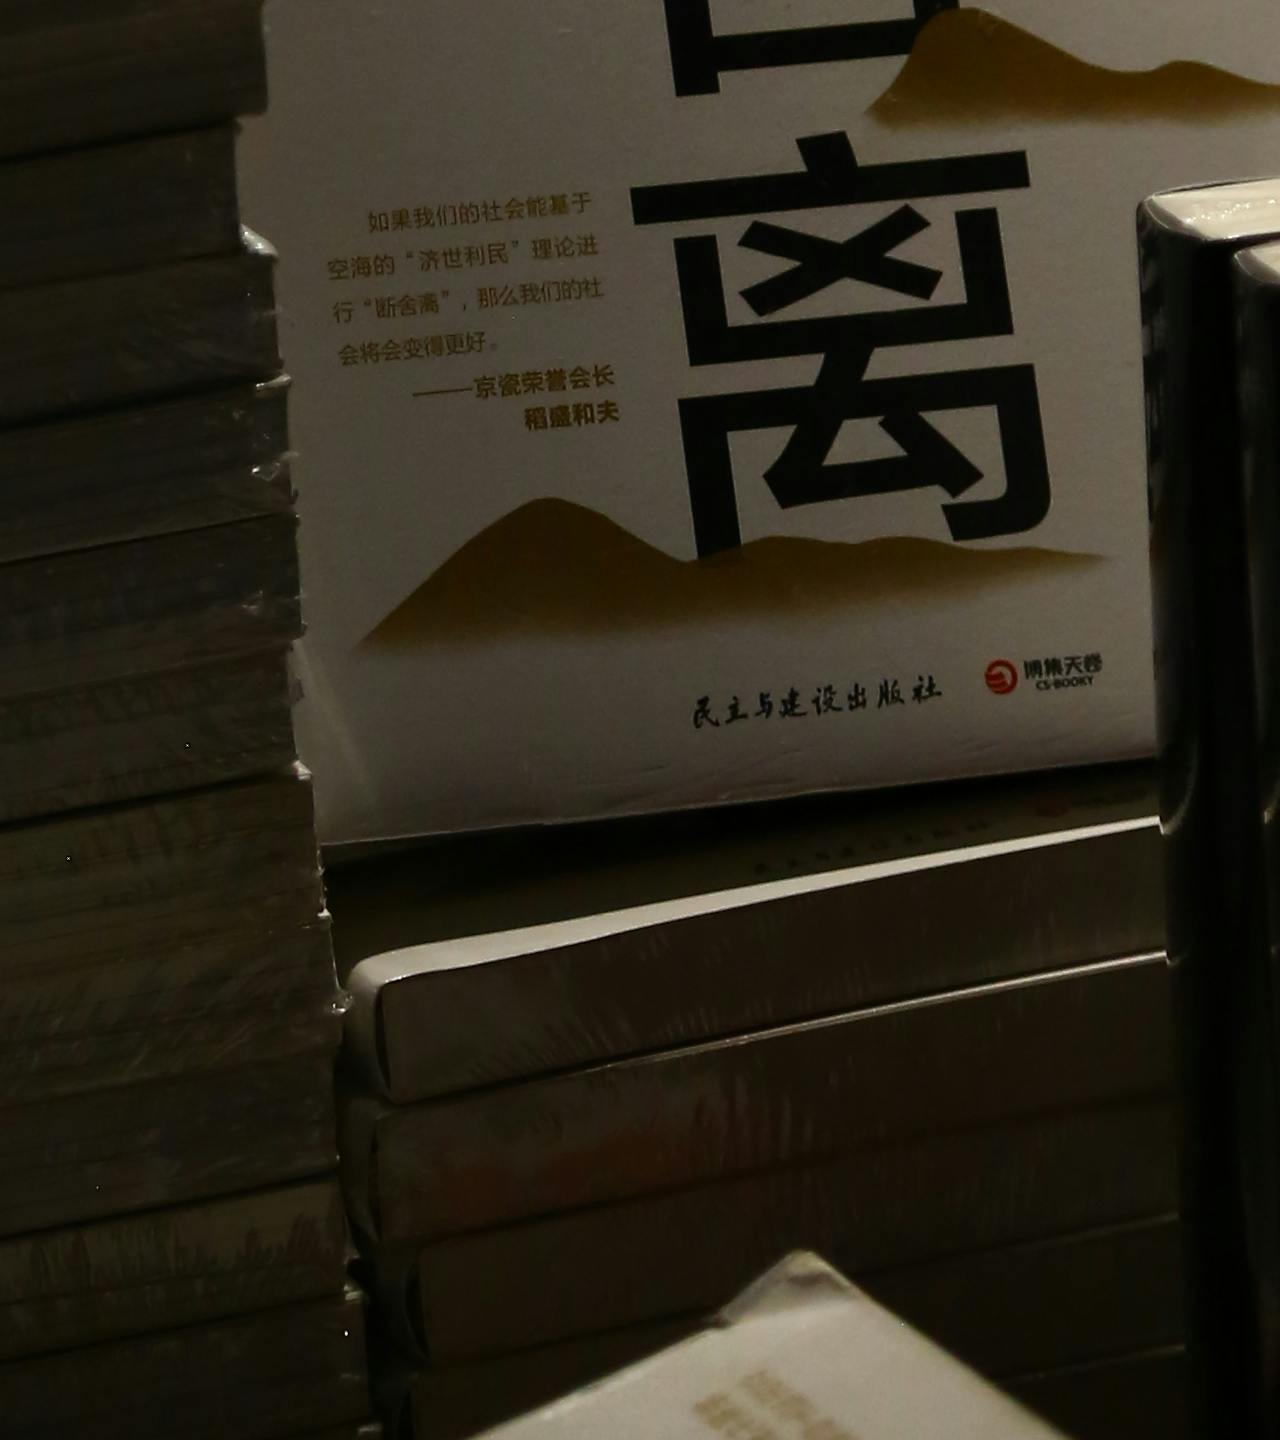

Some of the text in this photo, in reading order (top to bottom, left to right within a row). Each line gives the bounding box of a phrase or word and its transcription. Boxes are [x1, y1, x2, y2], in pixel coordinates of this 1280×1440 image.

[368, 190, 592, 233] 如果我们的社会能基于
[524, 399, 620, 432] 稻盛和夫
[692, 674, 944, 730] 民主与建设出版社
